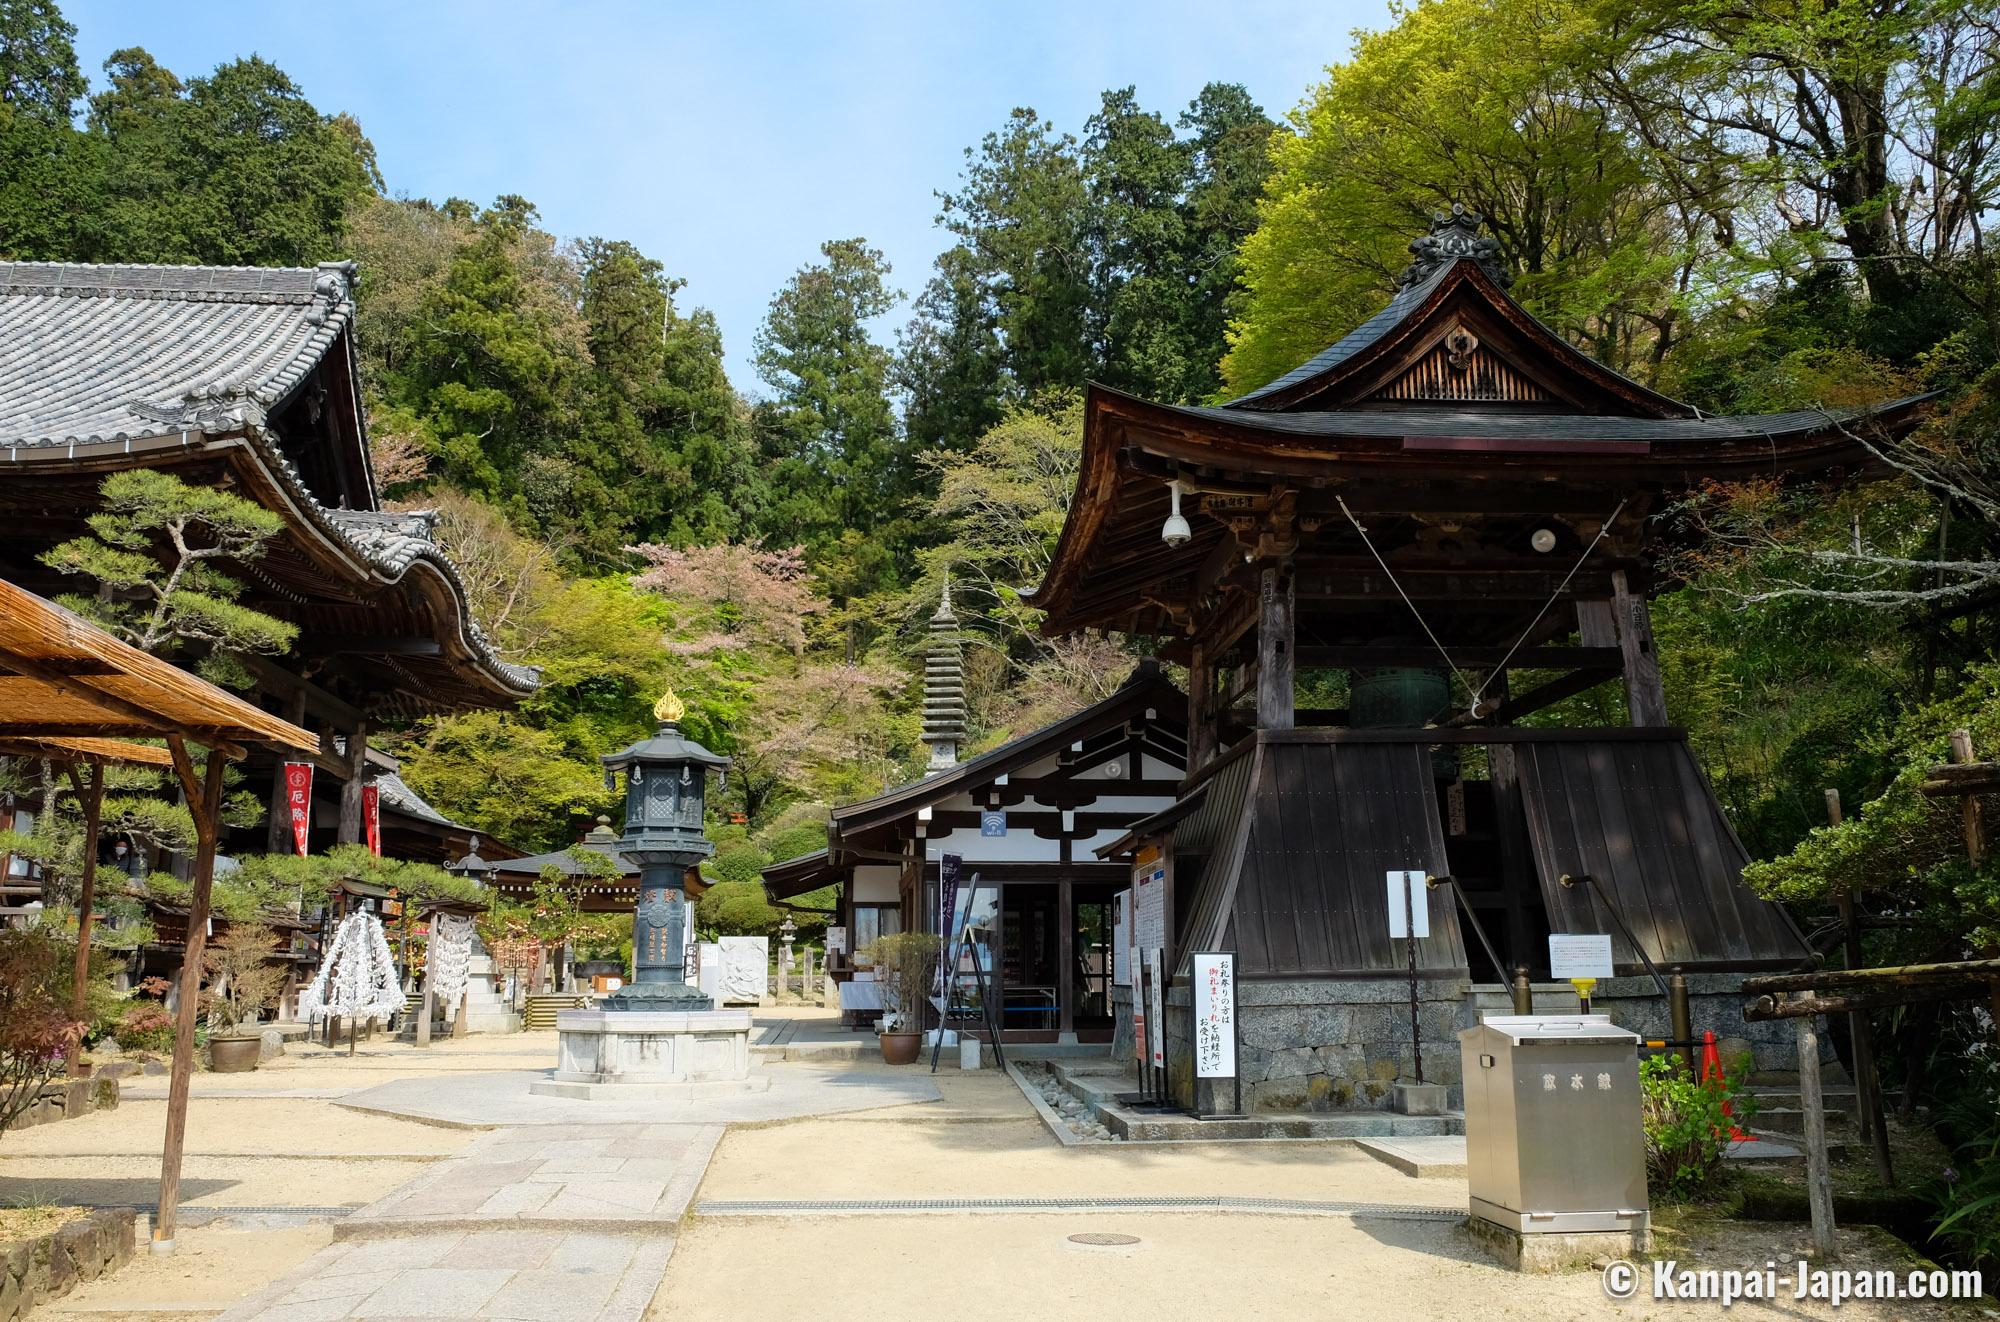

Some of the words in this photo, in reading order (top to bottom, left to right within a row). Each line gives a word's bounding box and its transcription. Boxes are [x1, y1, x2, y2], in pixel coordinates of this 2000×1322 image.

[1199, 1017, 1210, 1072] お受け下さい
